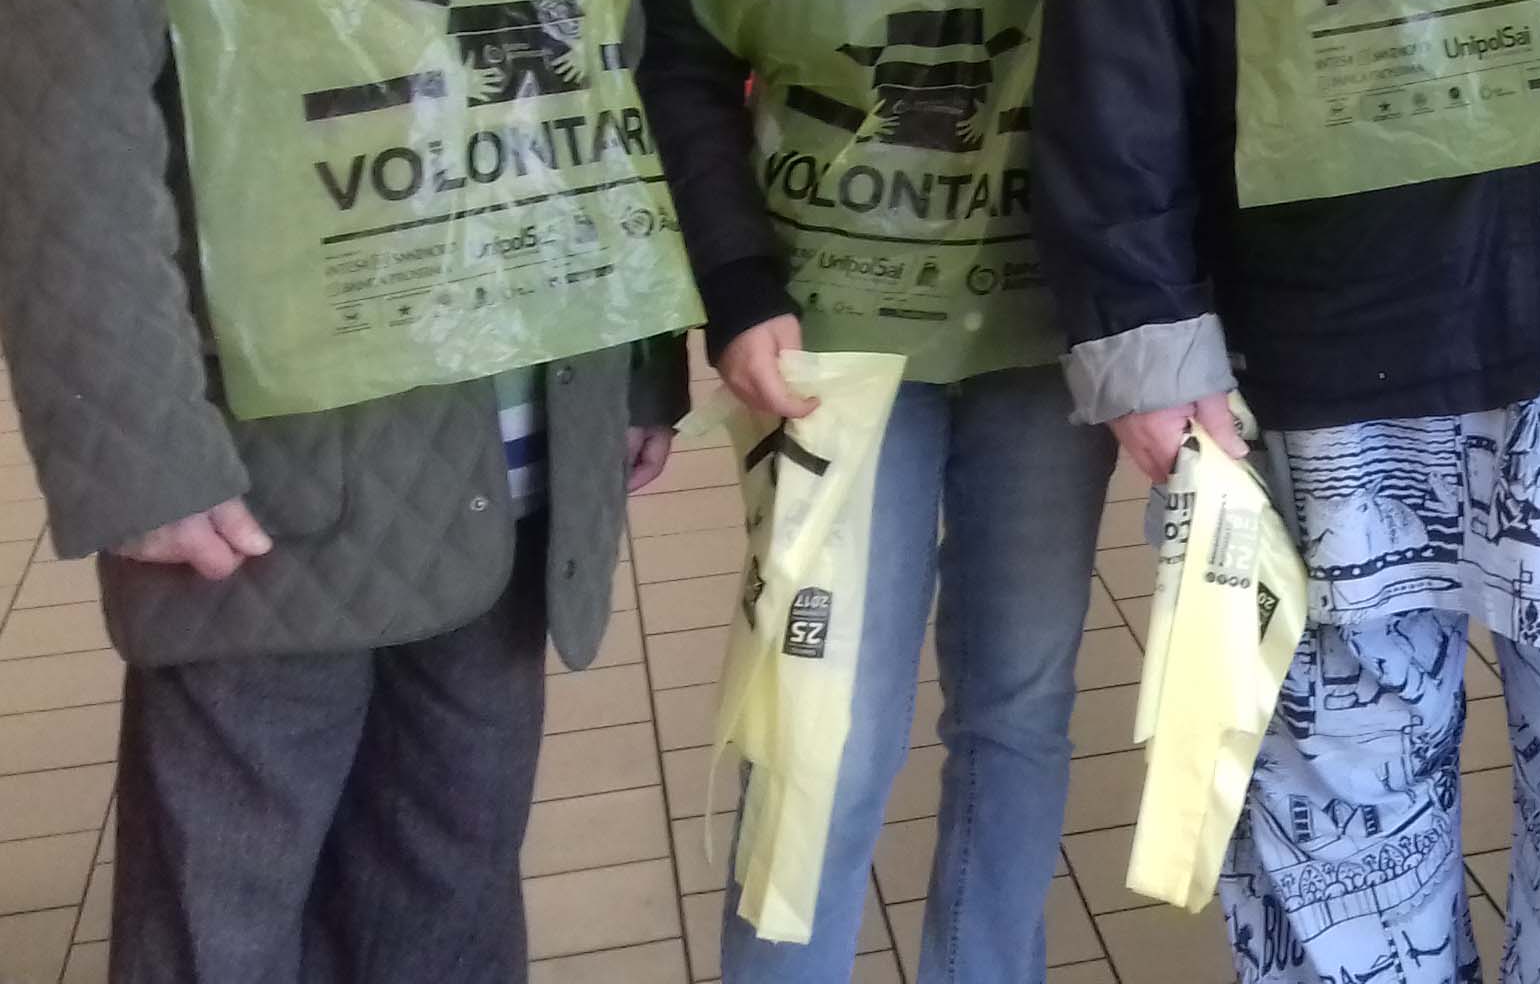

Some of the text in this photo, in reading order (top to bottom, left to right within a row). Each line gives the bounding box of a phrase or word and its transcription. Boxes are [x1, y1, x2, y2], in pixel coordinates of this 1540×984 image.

[1442, 25, 1532, 60] UnipolSai
[314, 106, 657, 211] VOLONTAR
[764, 149, 1034, 220] VOLONTAR
[789, 621, 824, 645] 25
